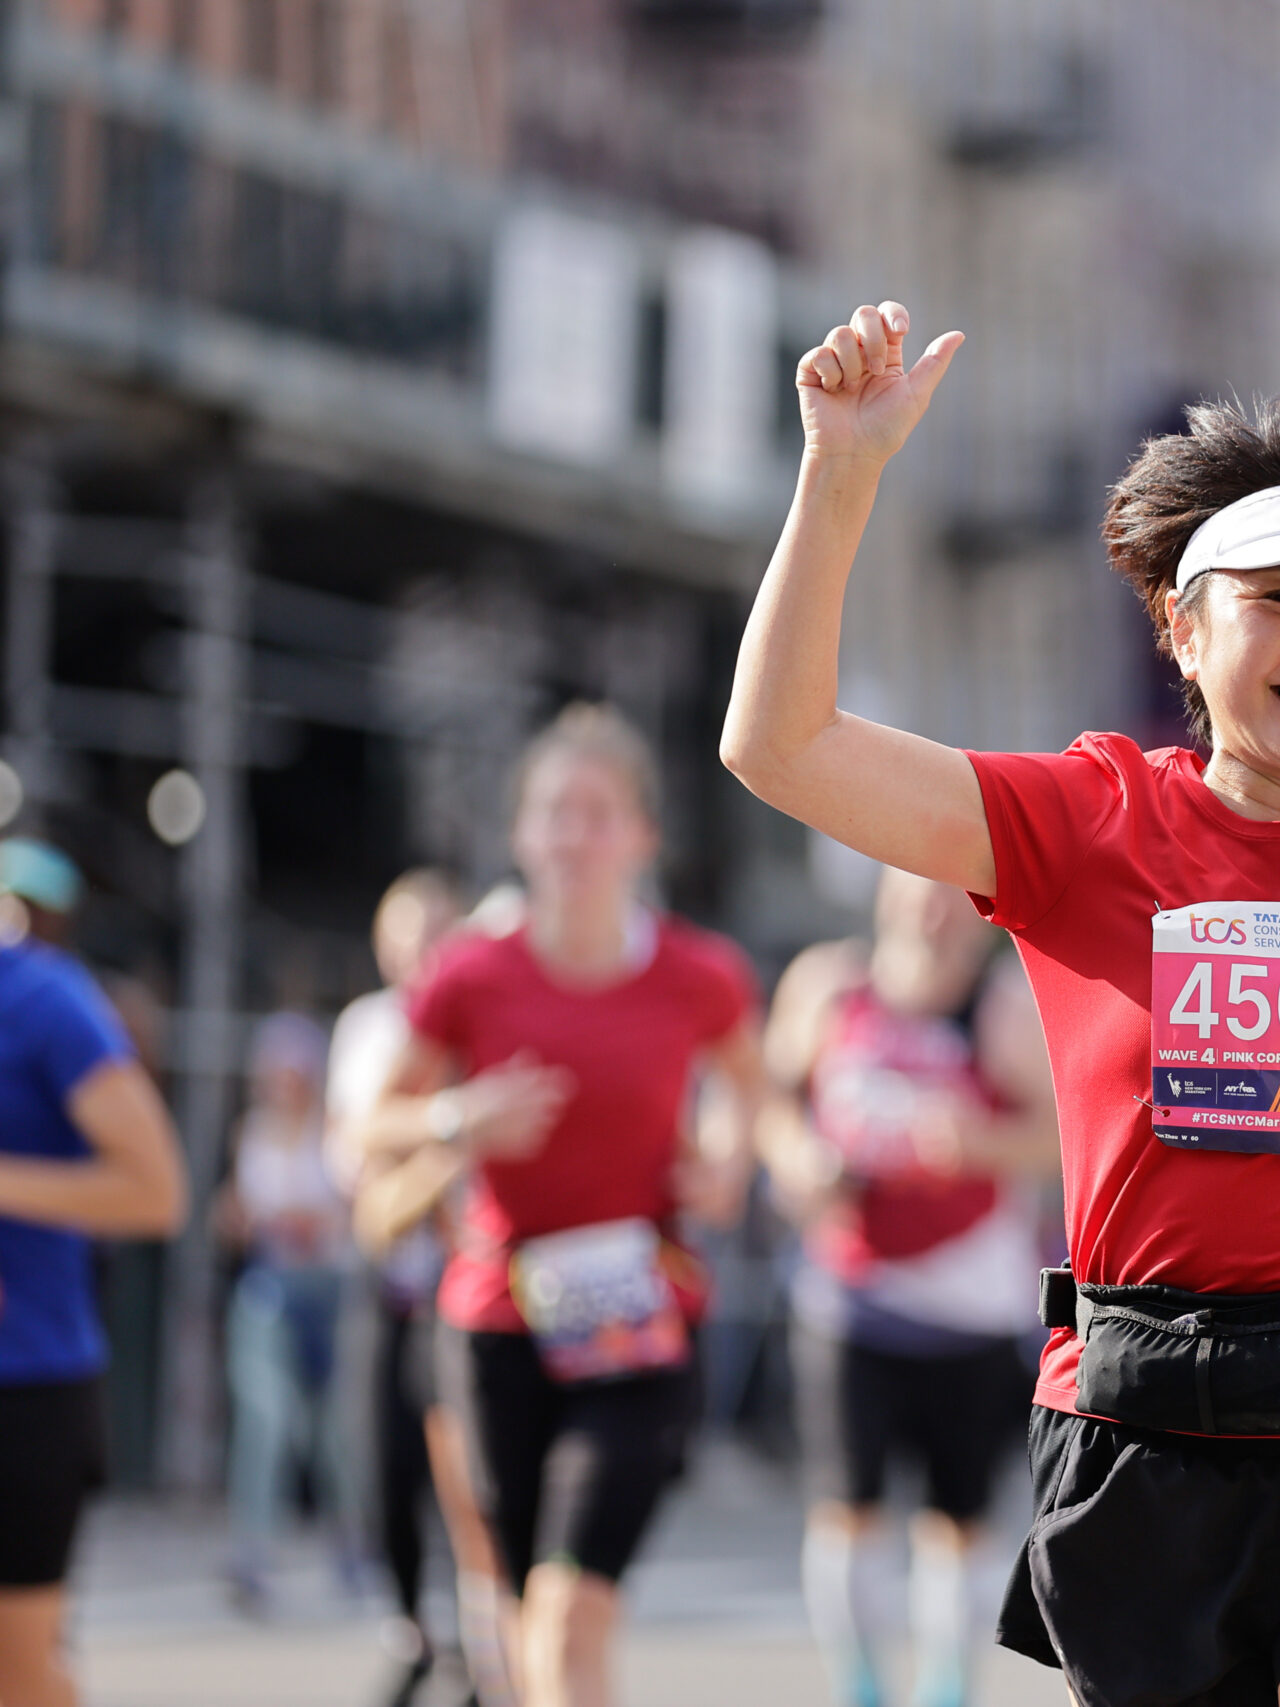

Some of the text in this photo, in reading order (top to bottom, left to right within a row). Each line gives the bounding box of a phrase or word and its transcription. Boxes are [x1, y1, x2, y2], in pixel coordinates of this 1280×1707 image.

[1189, 912, 1247, 945] tcs
[1158, 1047, 1216, 1065] WAVE 4
[1223, 1051, 1254, 1063] PINK
